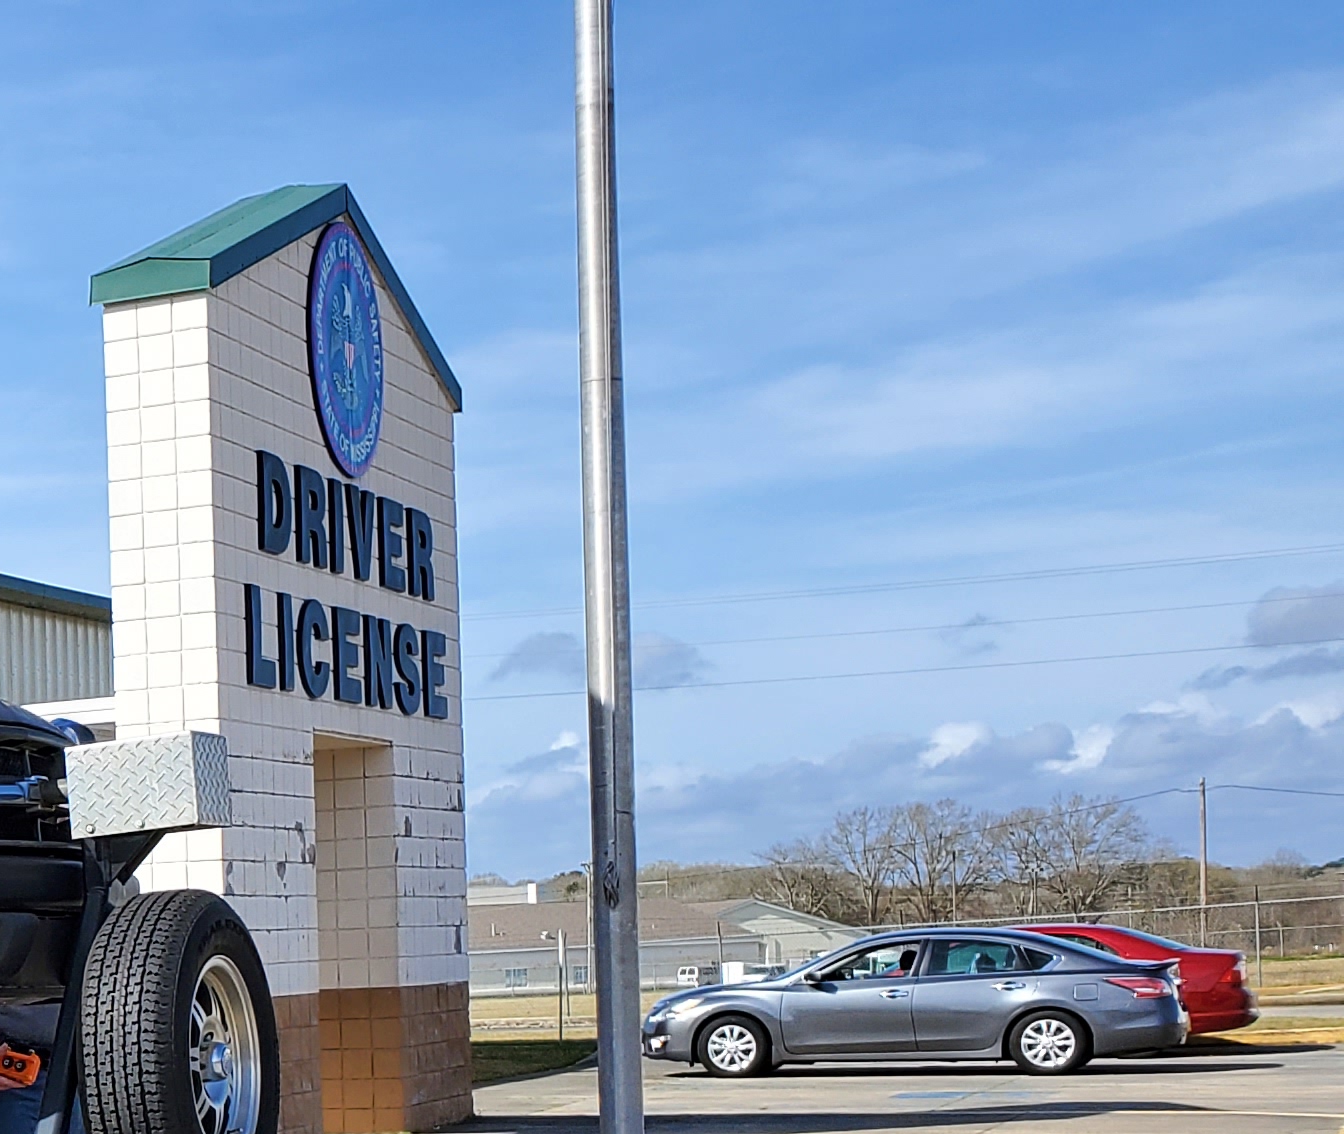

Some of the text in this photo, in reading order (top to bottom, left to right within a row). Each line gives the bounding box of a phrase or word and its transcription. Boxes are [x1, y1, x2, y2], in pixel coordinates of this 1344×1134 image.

[315, 237, 382, 384] DEPARTMENT OF PUBLIC SAFETY
[321, 379, 339, 442] STATE
[339, 433, 349, 458] OF
[254, 450, 435, 601] DRIVER
[243, 583, 448, 719] LICENSE
